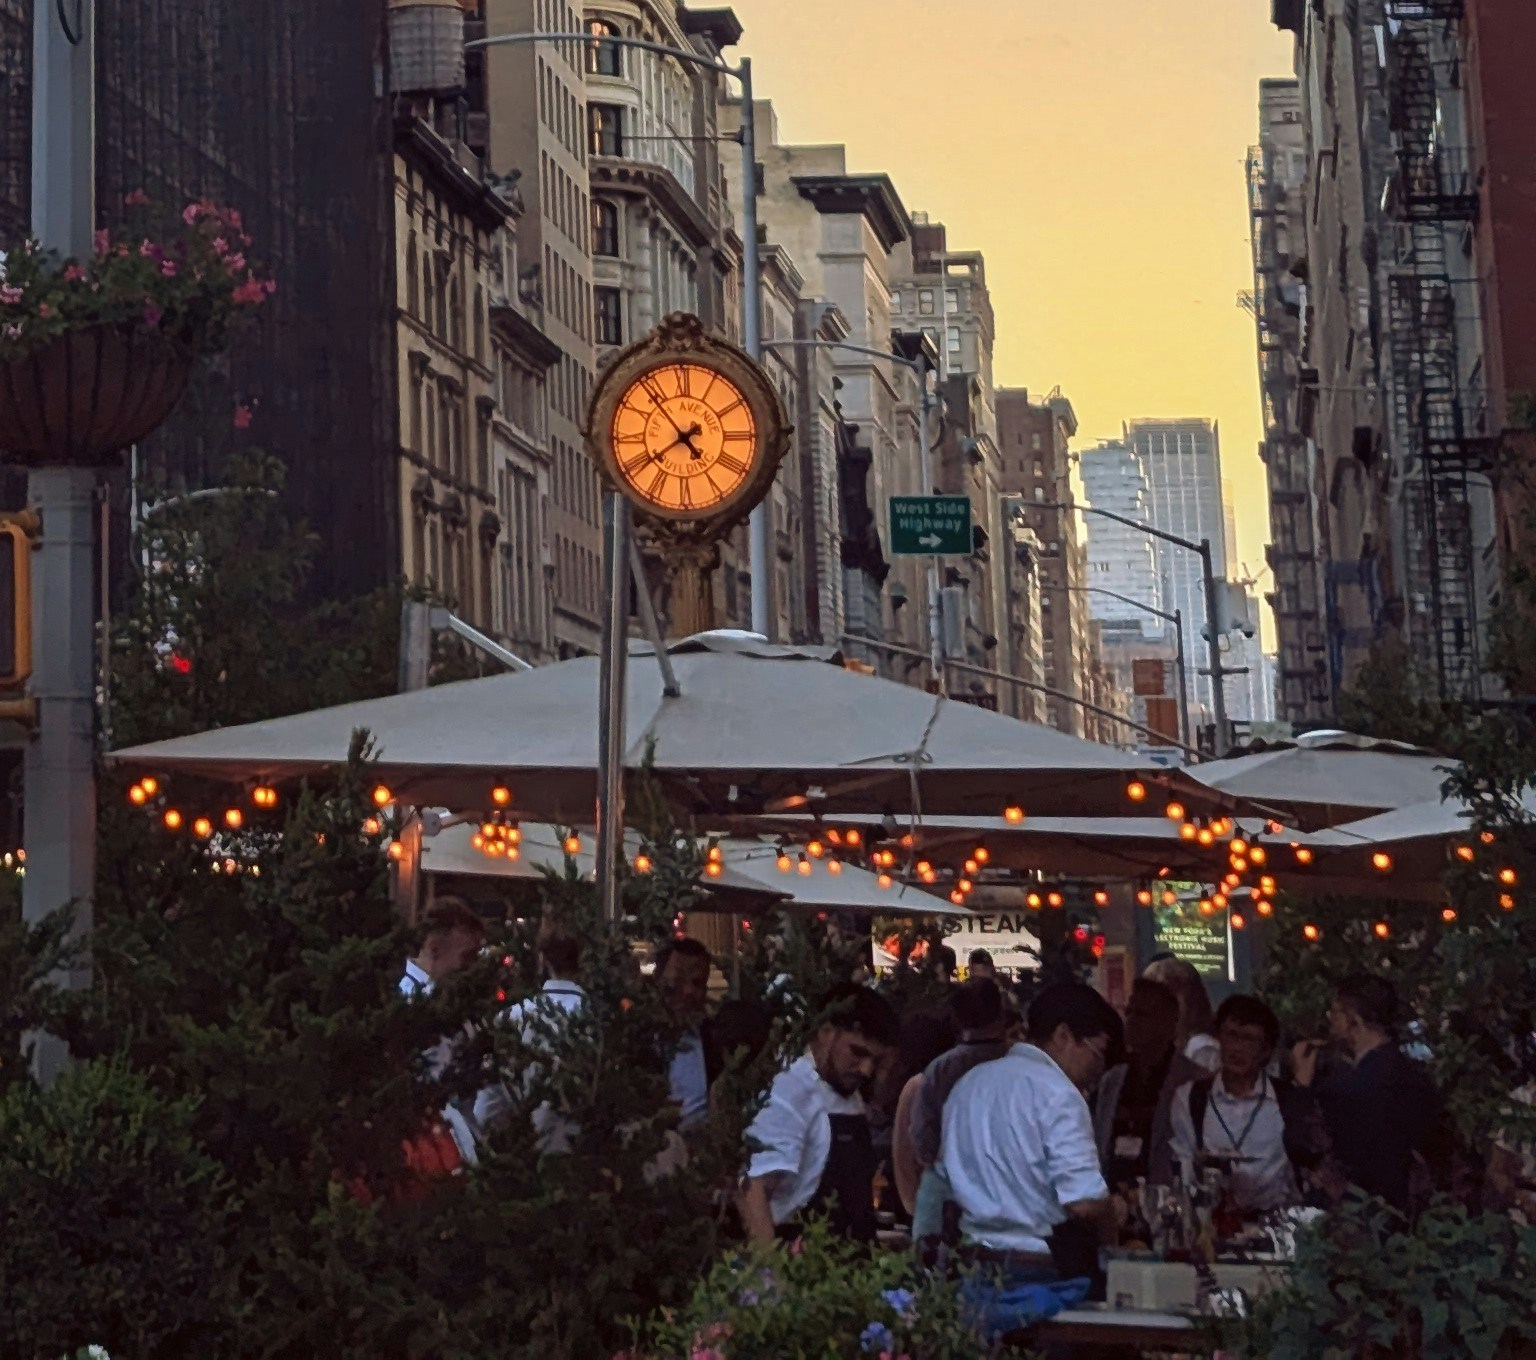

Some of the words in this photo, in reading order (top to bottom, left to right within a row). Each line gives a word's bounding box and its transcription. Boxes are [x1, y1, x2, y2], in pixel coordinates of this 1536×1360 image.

[679, 401, 720, 435] AVENUE
[661, 453, 714, 474] UILDING
[894, 502, 930, 514] West
[934, 501, 966, 515] Side
[899, 517, 962, 533] Highway
